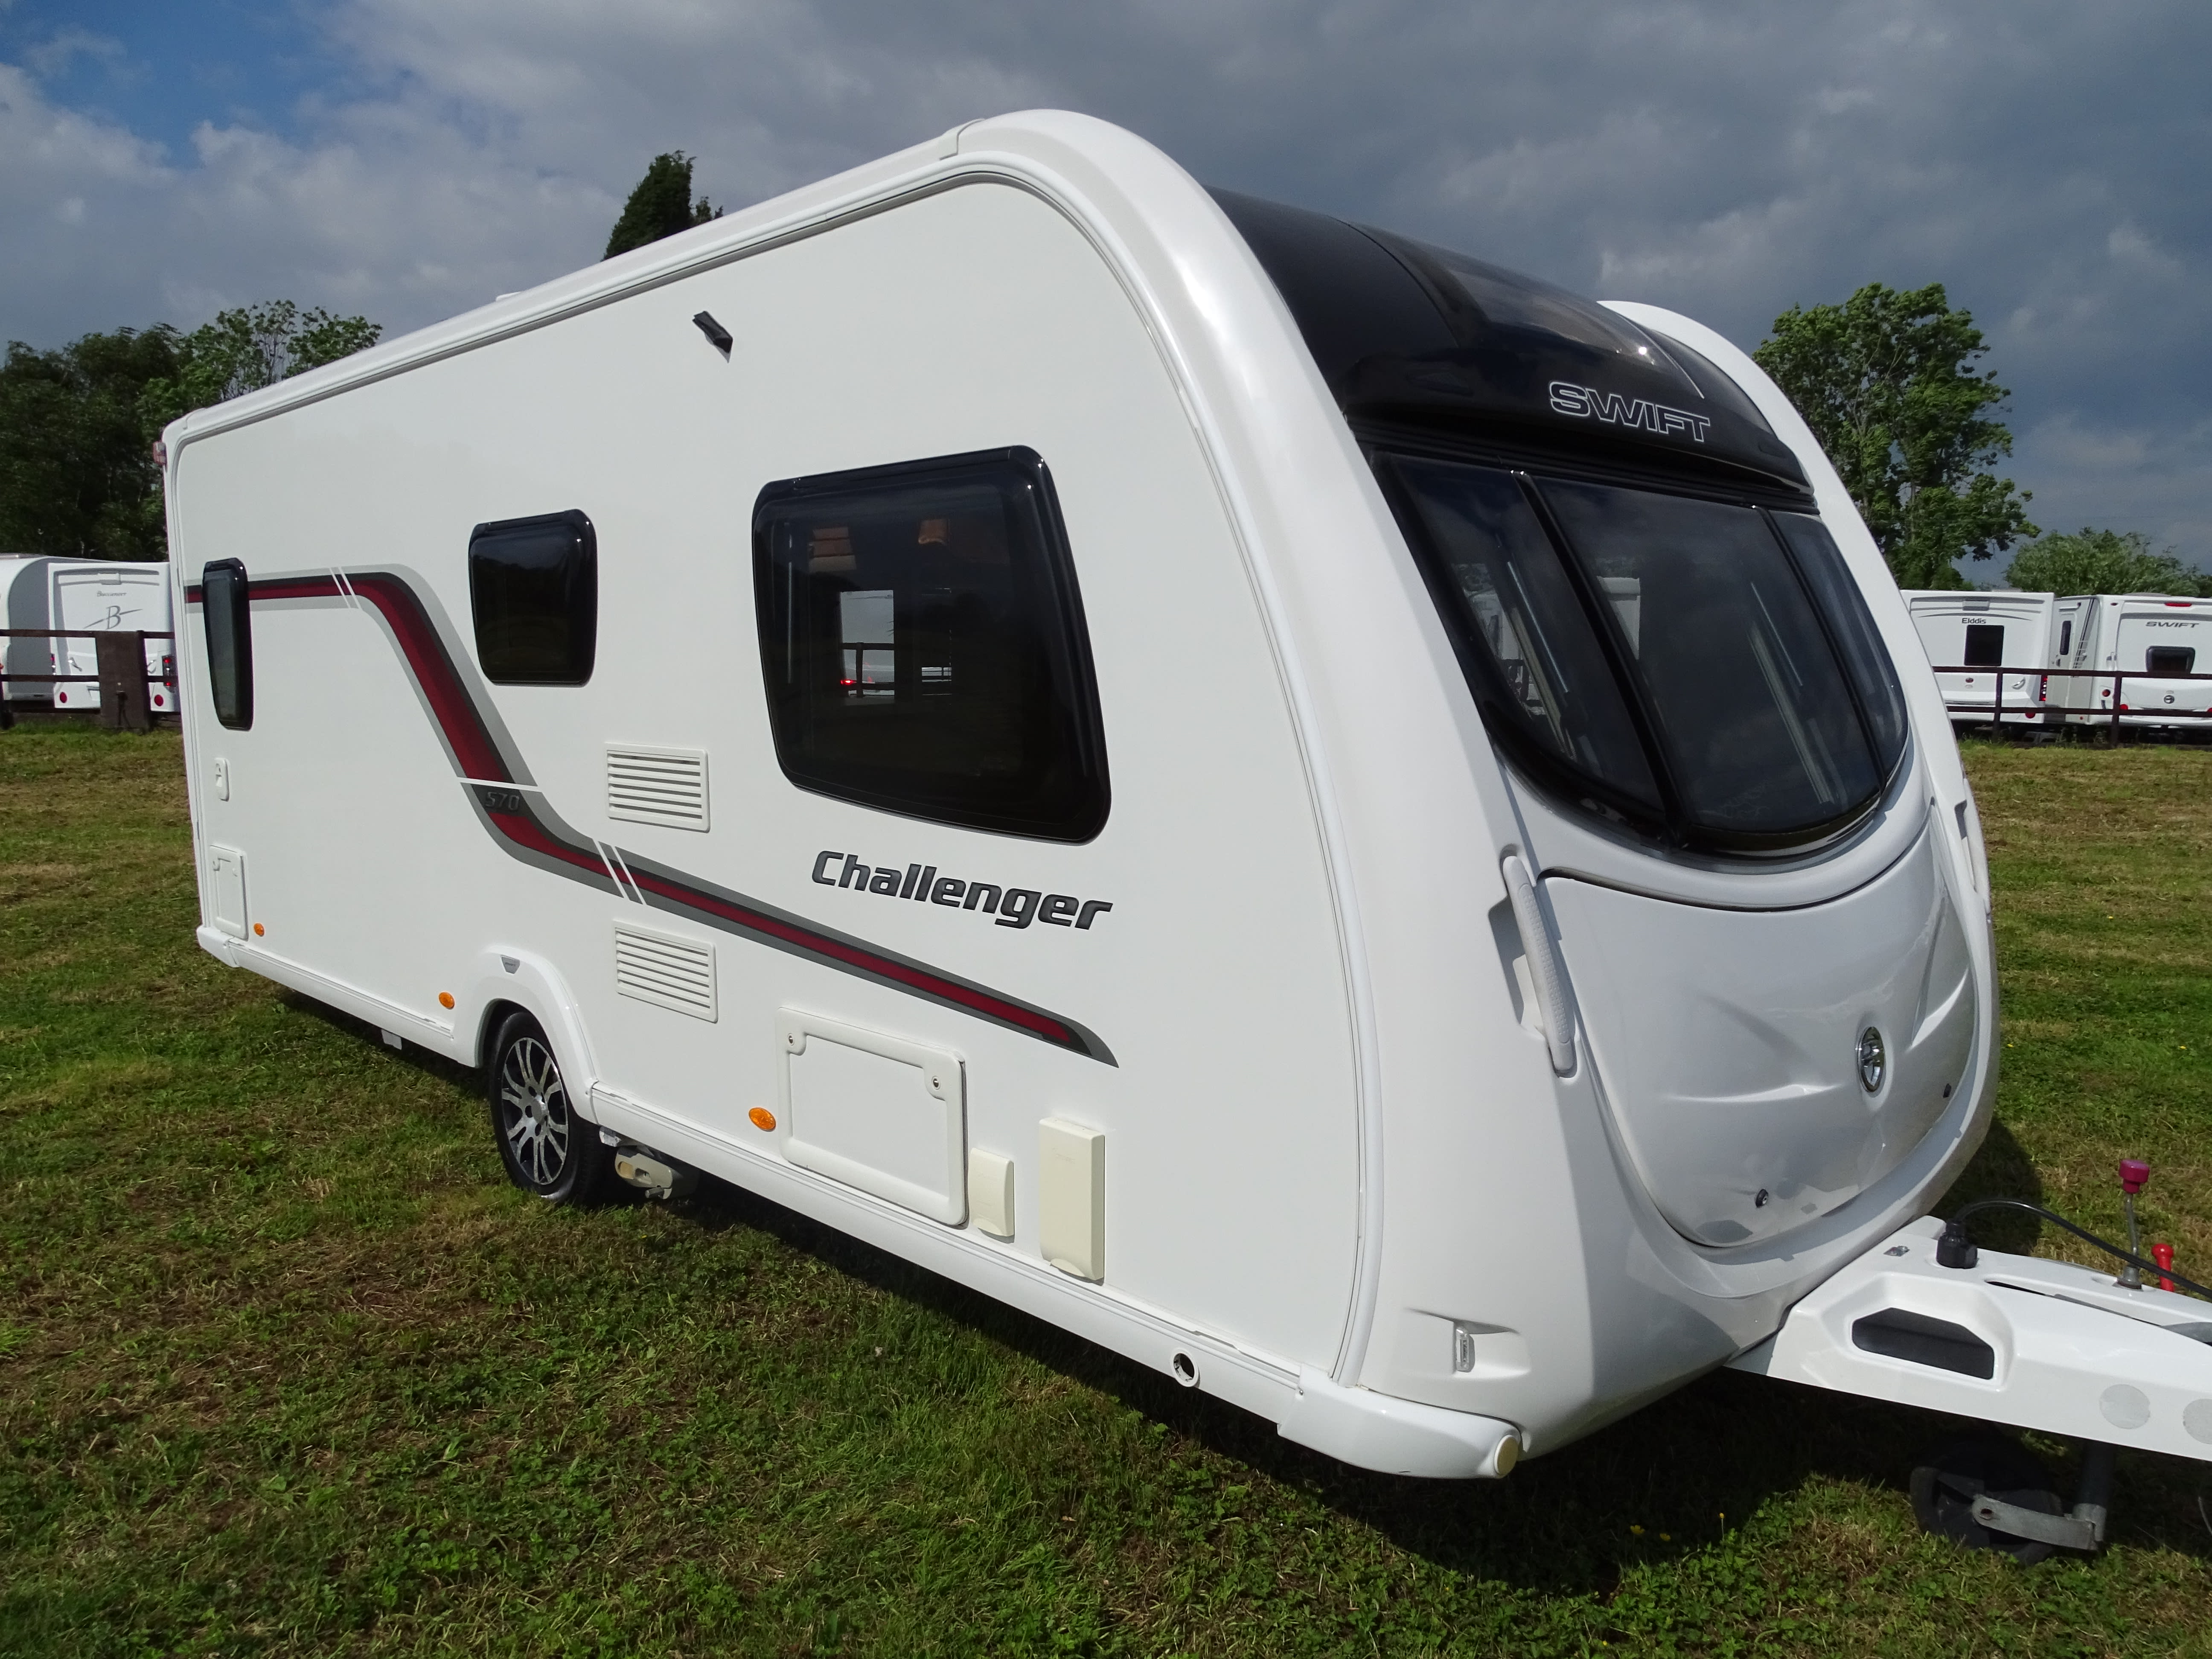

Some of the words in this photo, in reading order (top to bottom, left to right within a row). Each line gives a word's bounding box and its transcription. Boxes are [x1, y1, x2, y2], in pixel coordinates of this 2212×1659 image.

[1548, 381, 1711, 442] SWIFT
[486, 792, 520, 810] 570
[812, 850, 1113, 930] Challenger
